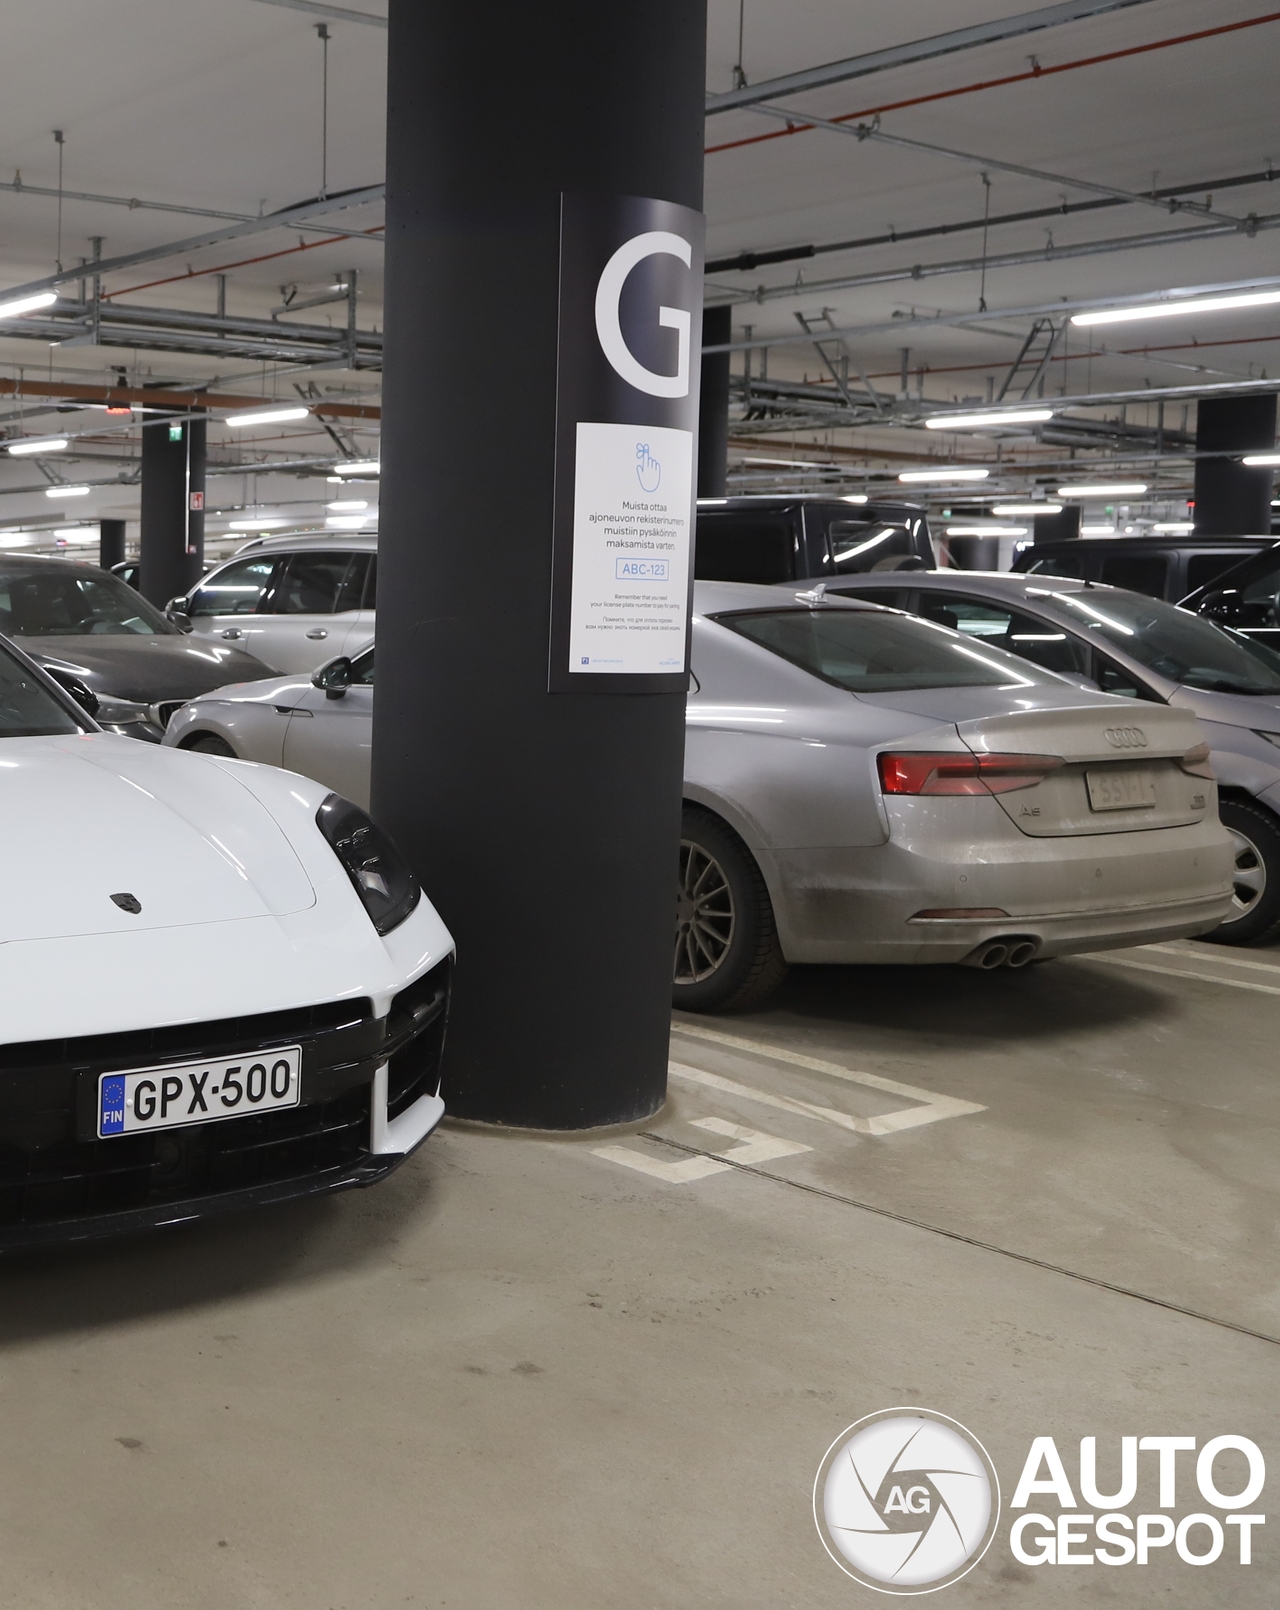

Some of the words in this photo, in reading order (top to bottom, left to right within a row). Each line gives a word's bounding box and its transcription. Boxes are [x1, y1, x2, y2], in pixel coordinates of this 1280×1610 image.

[595, 231, 692, 399] G
[622, 501, 649, 511] Muista
[650, 503, 668, 512] ottaa
[589, 512, 636, 524] ajoneuvon
[636, 515, 685, 526] rekisterinumero
[604, 526, 638, 536] muistiin
[639, 528, 677, 538] pysäköinnin
[606, 539, 655, 549] maksamista
[656, 542, 676, 551] varten.
[622, 563, 665, 576] ABC-123
[133, 1058, 291, 1121] GPX-500
[103, 1109, 123, 1125] FIN
